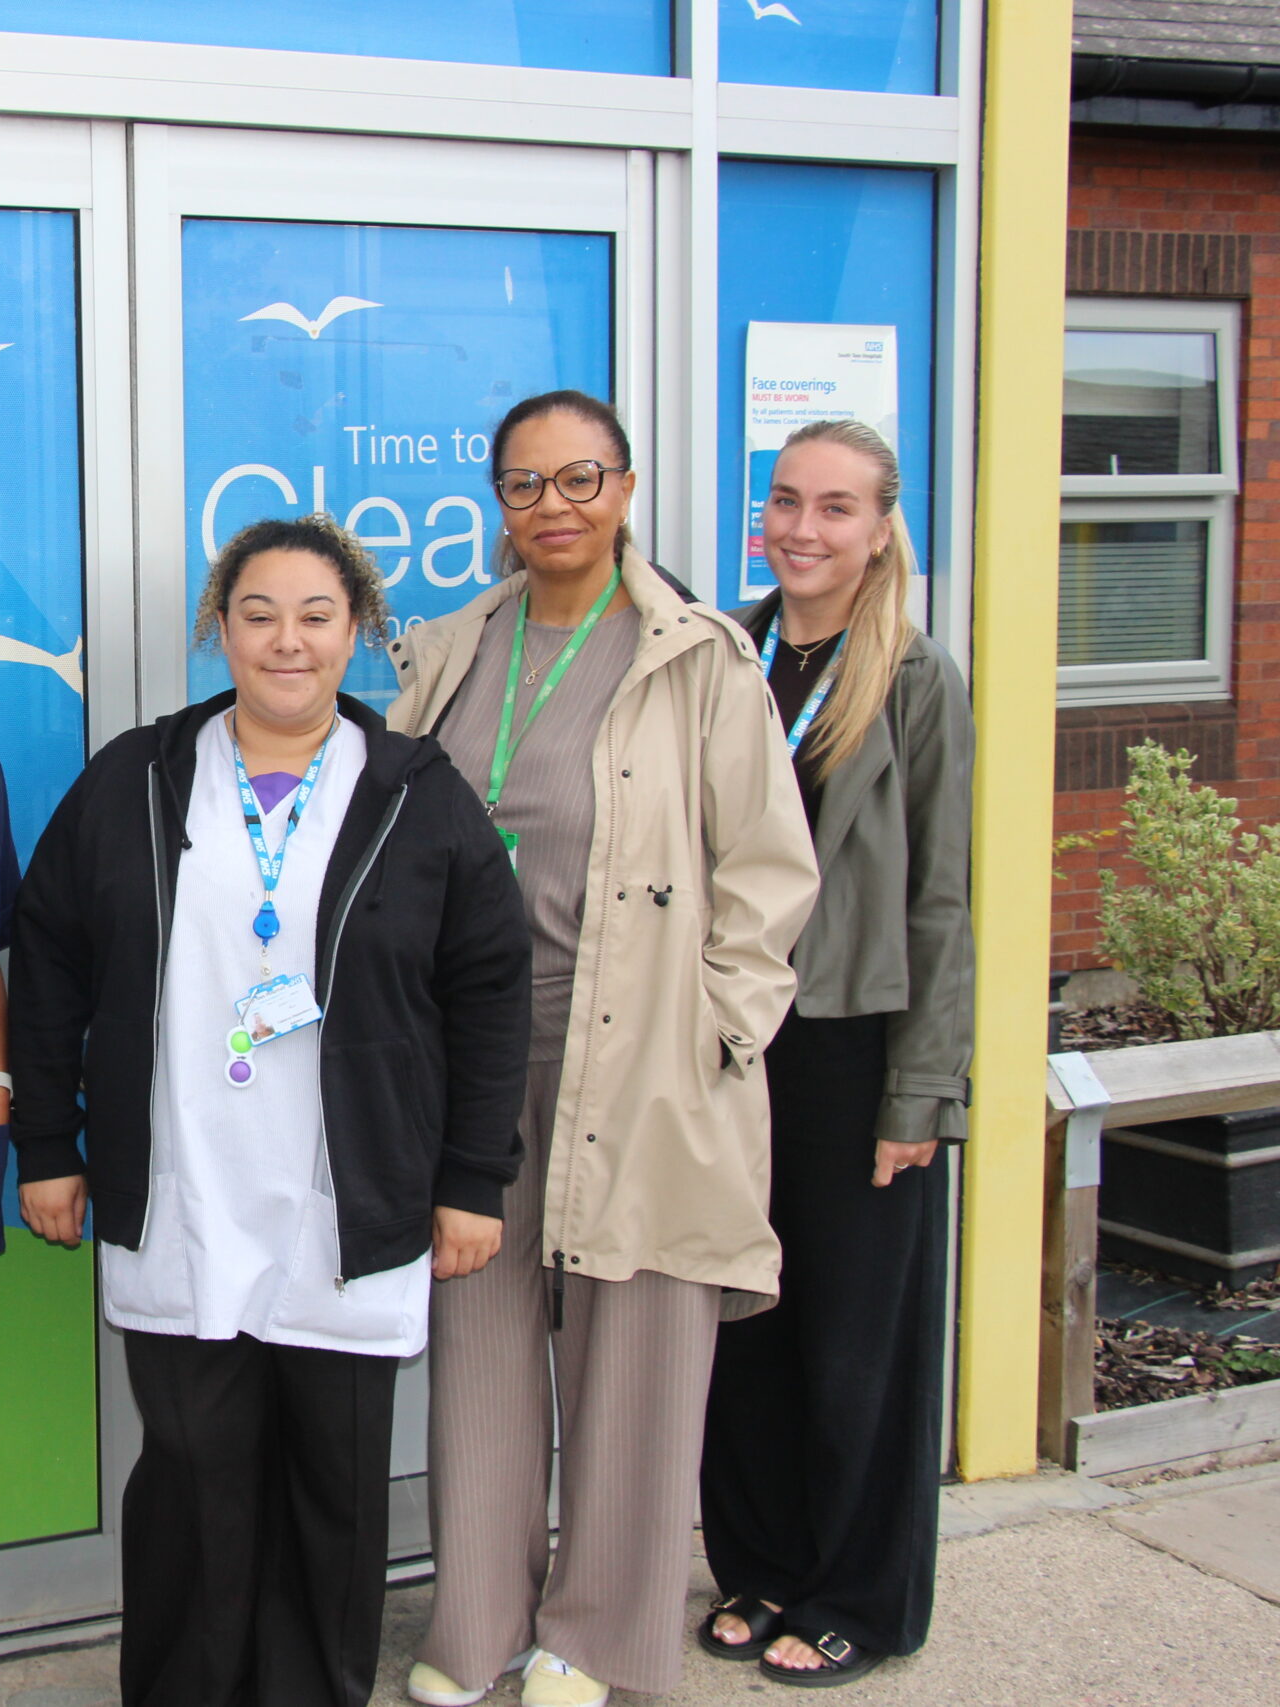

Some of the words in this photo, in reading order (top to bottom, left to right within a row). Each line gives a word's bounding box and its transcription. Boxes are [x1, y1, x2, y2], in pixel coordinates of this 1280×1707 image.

[866, 342, 883, 351] NHS
[752, 377, 777, 390] Face
[780, 378, 836, 394] coverings
[752, 394, 772, 402] MUST
[773, 394, 783, 402] BE
[784, 394, 809, 402] WORN
[752, 408, 759, 416] By
[768, 409, 794, 417] patients
[343, 426, 438, 465] Time
[451, 427, 490, 463] to
[764, 637, 775, 656] NHS
[806, 698, 821, 716] NHS
[794, 719, 808, 737] NHS
[236, 766, 248, 784] NHS
[306, 766, 319, 782] NHS
[240, 788, 253, 805] NHS
[299, 785, 310, 804] NHS
[252, 837, 267, 854] NHS
[259, 857, 272, 876] NHS
[271, 859, 282, 880] NHS
